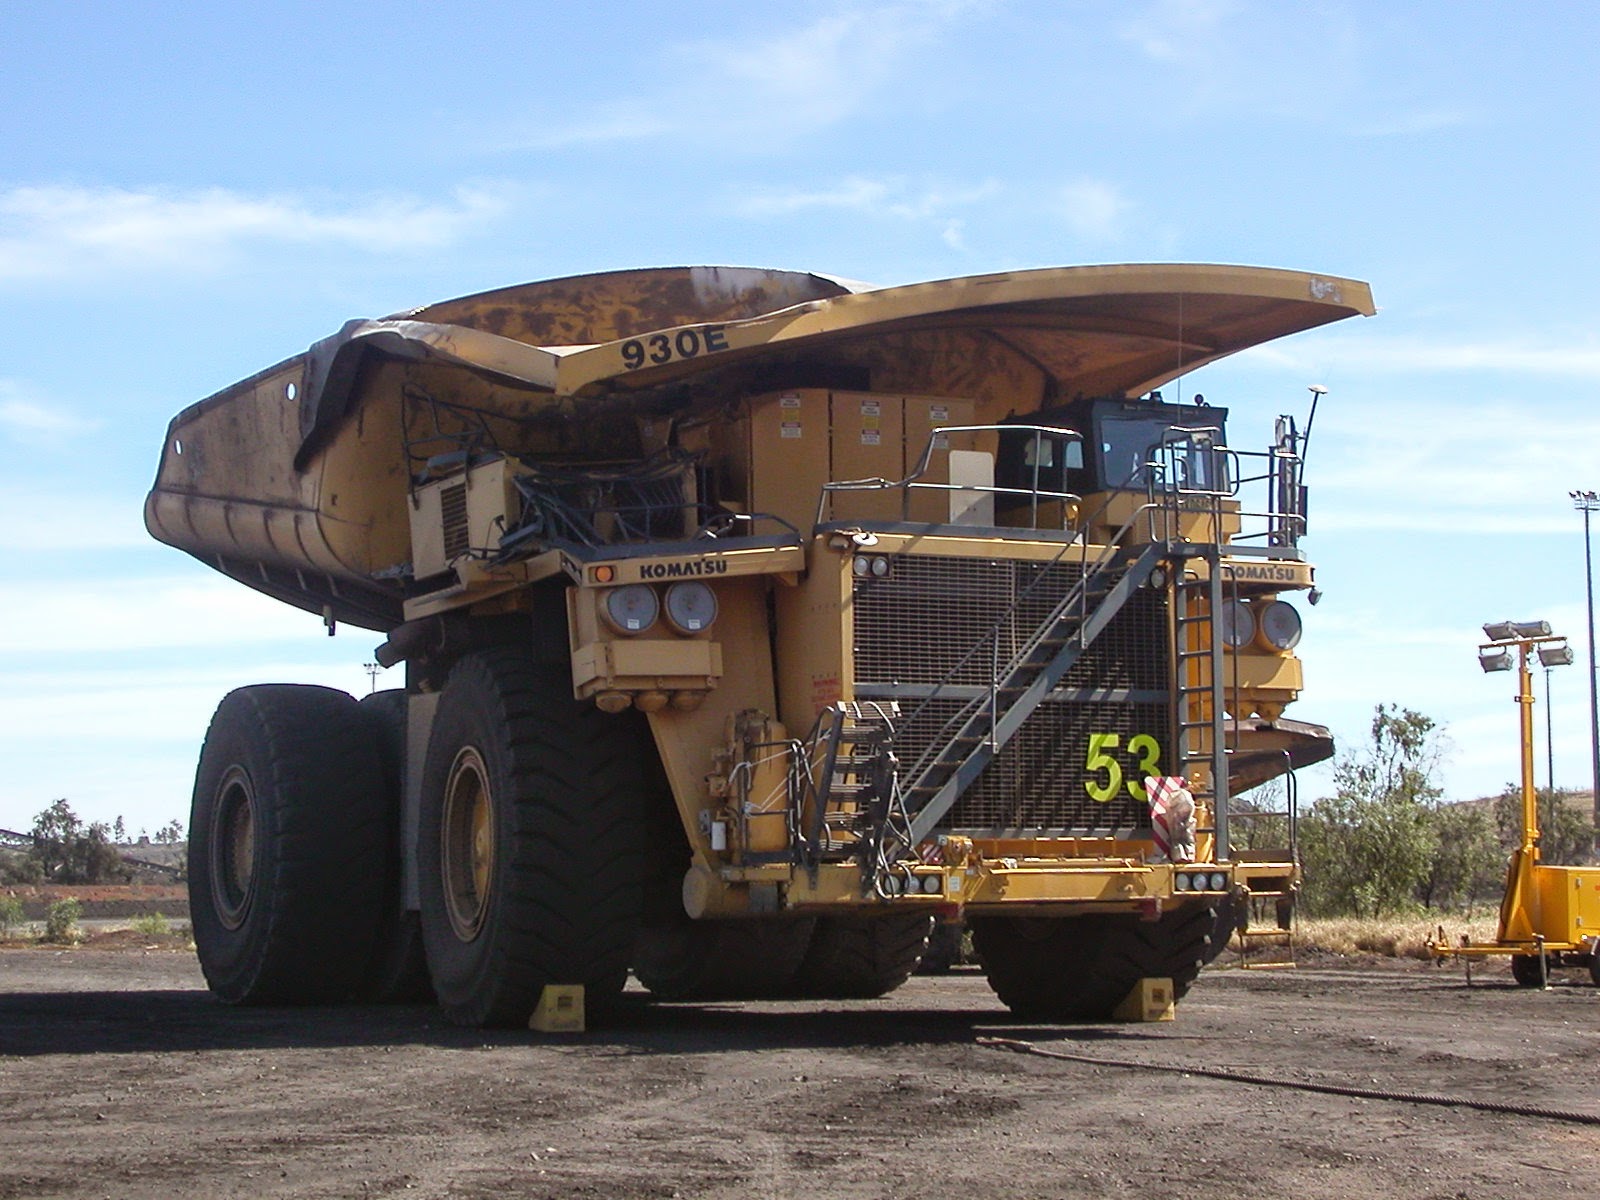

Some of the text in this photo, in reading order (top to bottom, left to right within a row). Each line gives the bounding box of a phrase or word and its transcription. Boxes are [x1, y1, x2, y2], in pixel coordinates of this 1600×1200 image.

[621, 325, 729, 369] 930E
[640, 558, 727, 578] KOMATSU
[1085, 733, 1162, 802] 53
